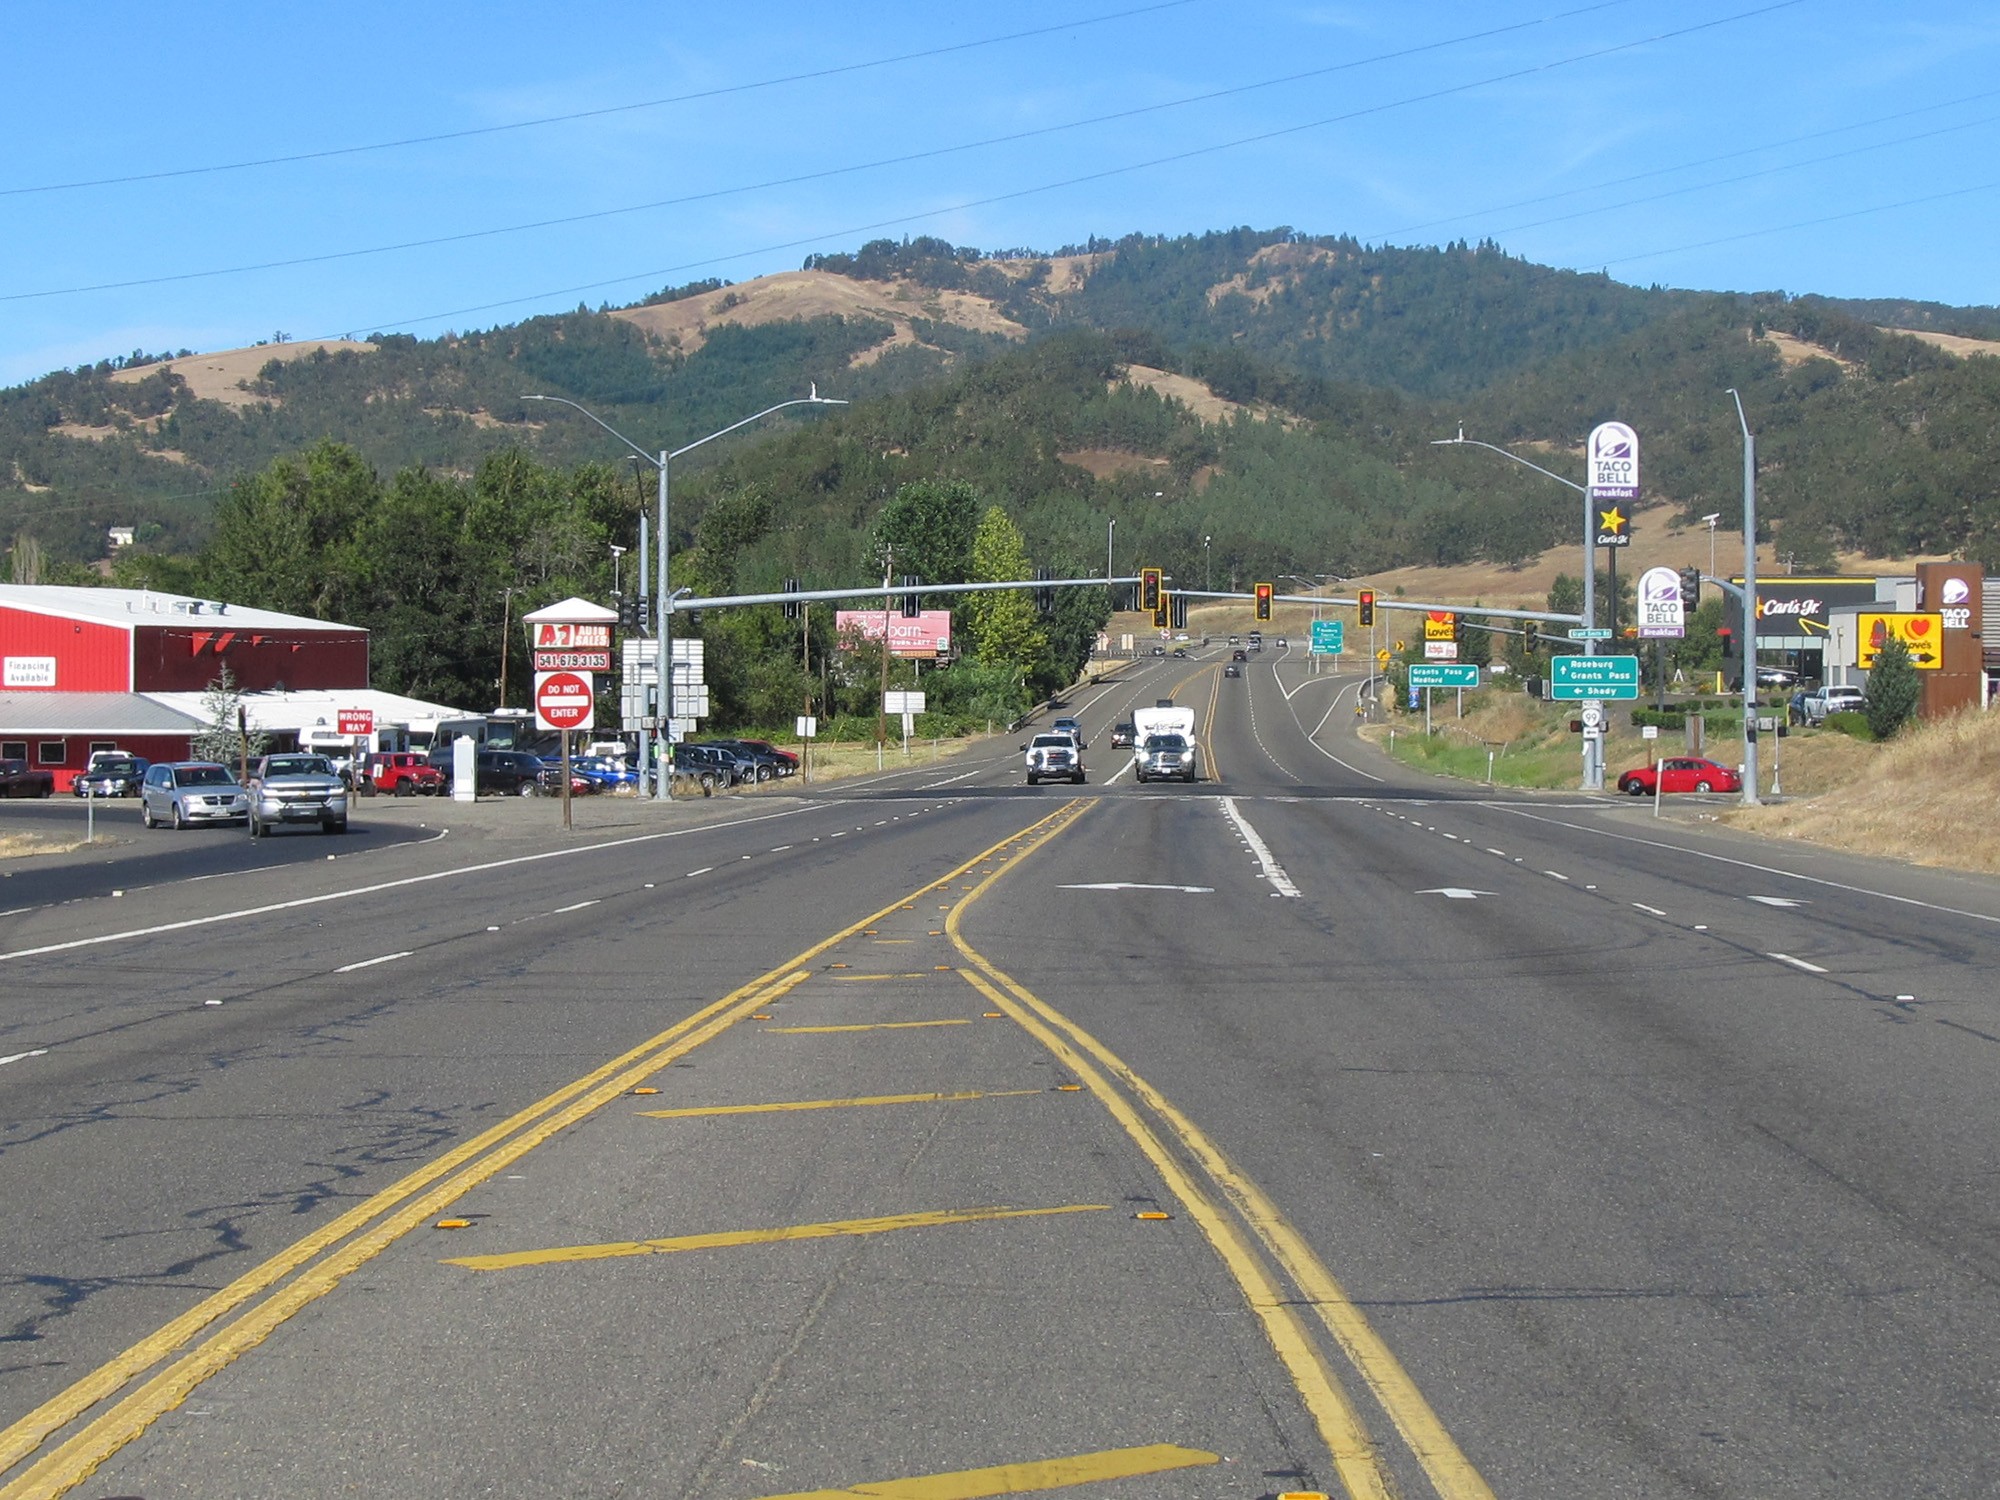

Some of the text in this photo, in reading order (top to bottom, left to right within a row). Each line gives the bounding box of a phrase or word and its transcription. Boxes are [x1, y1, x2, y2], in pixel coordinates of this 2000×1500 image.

[1595, 461, 1632, 472] TACO
[1597, 473, 1631, 484] BELL
[1593, 488, 1633, 498] Breakfast
[1645, 603, 1678, 613] TACO
[1763, 599, 1800, 616] Carl's
[1940, 608, 1970, 619] TACO
[1647, 614, 1677, 624] BELL
[1942, 618, 1969, 628] BELL
[578, 626, 607, 635] AUTO
[1644, 628, 1679, 637] Breakfast
[575, 636, 607, 647] SALES
[1905, 640, 1932, 649] ove's
[9, 660, 50, 673] Financing
[1570, 660, 1614, 670] Roseburg
[1412, 668, 1462, 676] Grants Pass
[1571, 672, 1631, 680] Grants Pass
[10, 673, 49, 683] Available
[1412, 676, 1443, 684] Medford
[548, 684, 580, 694] DO NOT
[1587, 687, 1617, 696] Shady
[339, 712, 371, 721] WRONG
[550, 708, 579, 718] ENTER
[1585, 713, 1597, 722] 99
[345, 723, 366, 732] WAY
